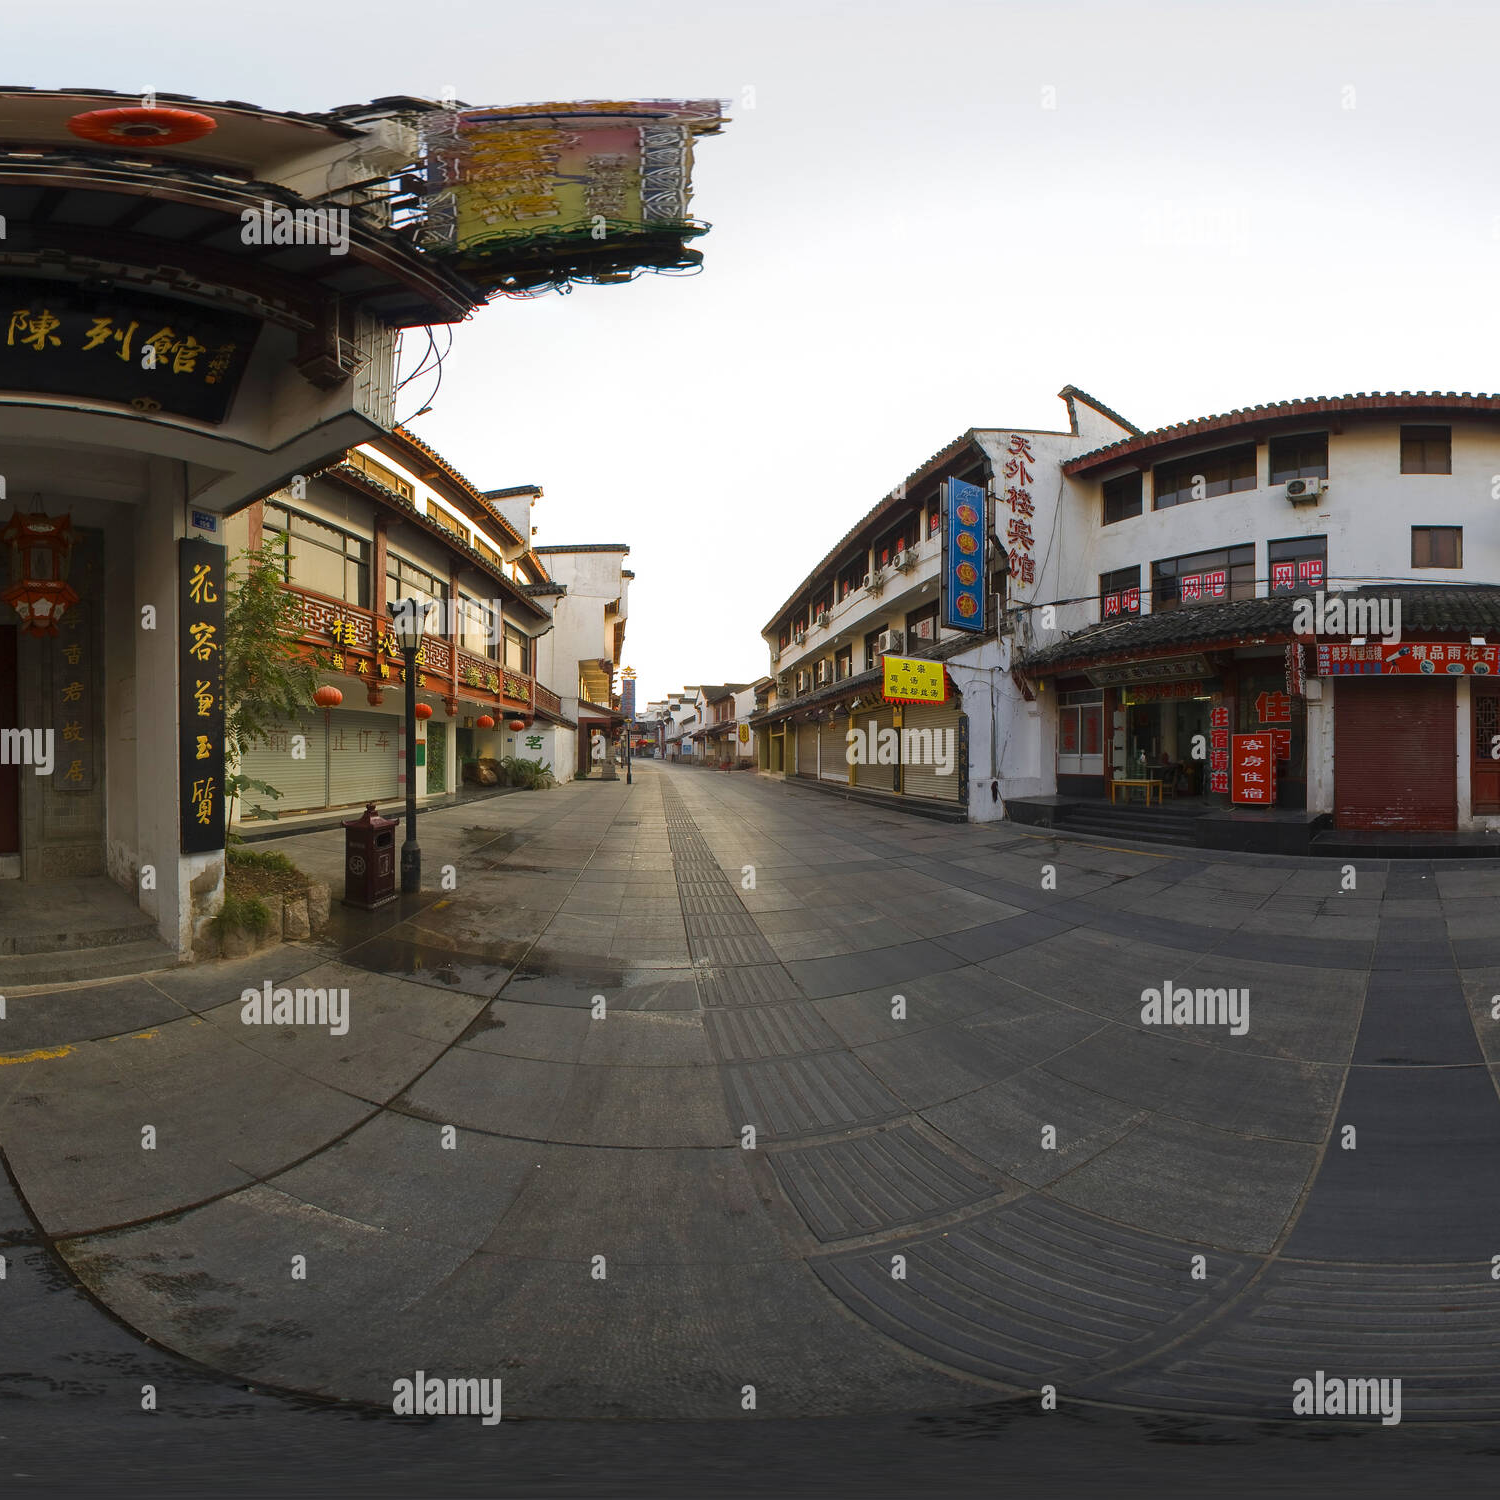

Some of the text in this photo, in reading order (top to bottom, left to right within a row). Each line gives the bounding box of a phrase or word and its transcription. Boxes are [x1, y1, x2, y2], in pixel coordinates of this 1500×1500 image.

[1005, 433, 1035, 585] 天外楼宾馆
[1181, 570, 1226, 602] 网吧
[1272, 560, 1324, 590] 网吧
[1104, 586, 1140, 617] 网吧
[1332, 646, 1383, 662] 俄罗斯望远镜
[1412, 645, 1497, 661] 精品雨花石
[901, 663, 926, 674] 正宗
[890, 685, 939, 698] 鸭血粉丝汤
[1209, 707, 1229, 793] 住宿请进
[1240, 739, 1265, 799] 客房住宿
